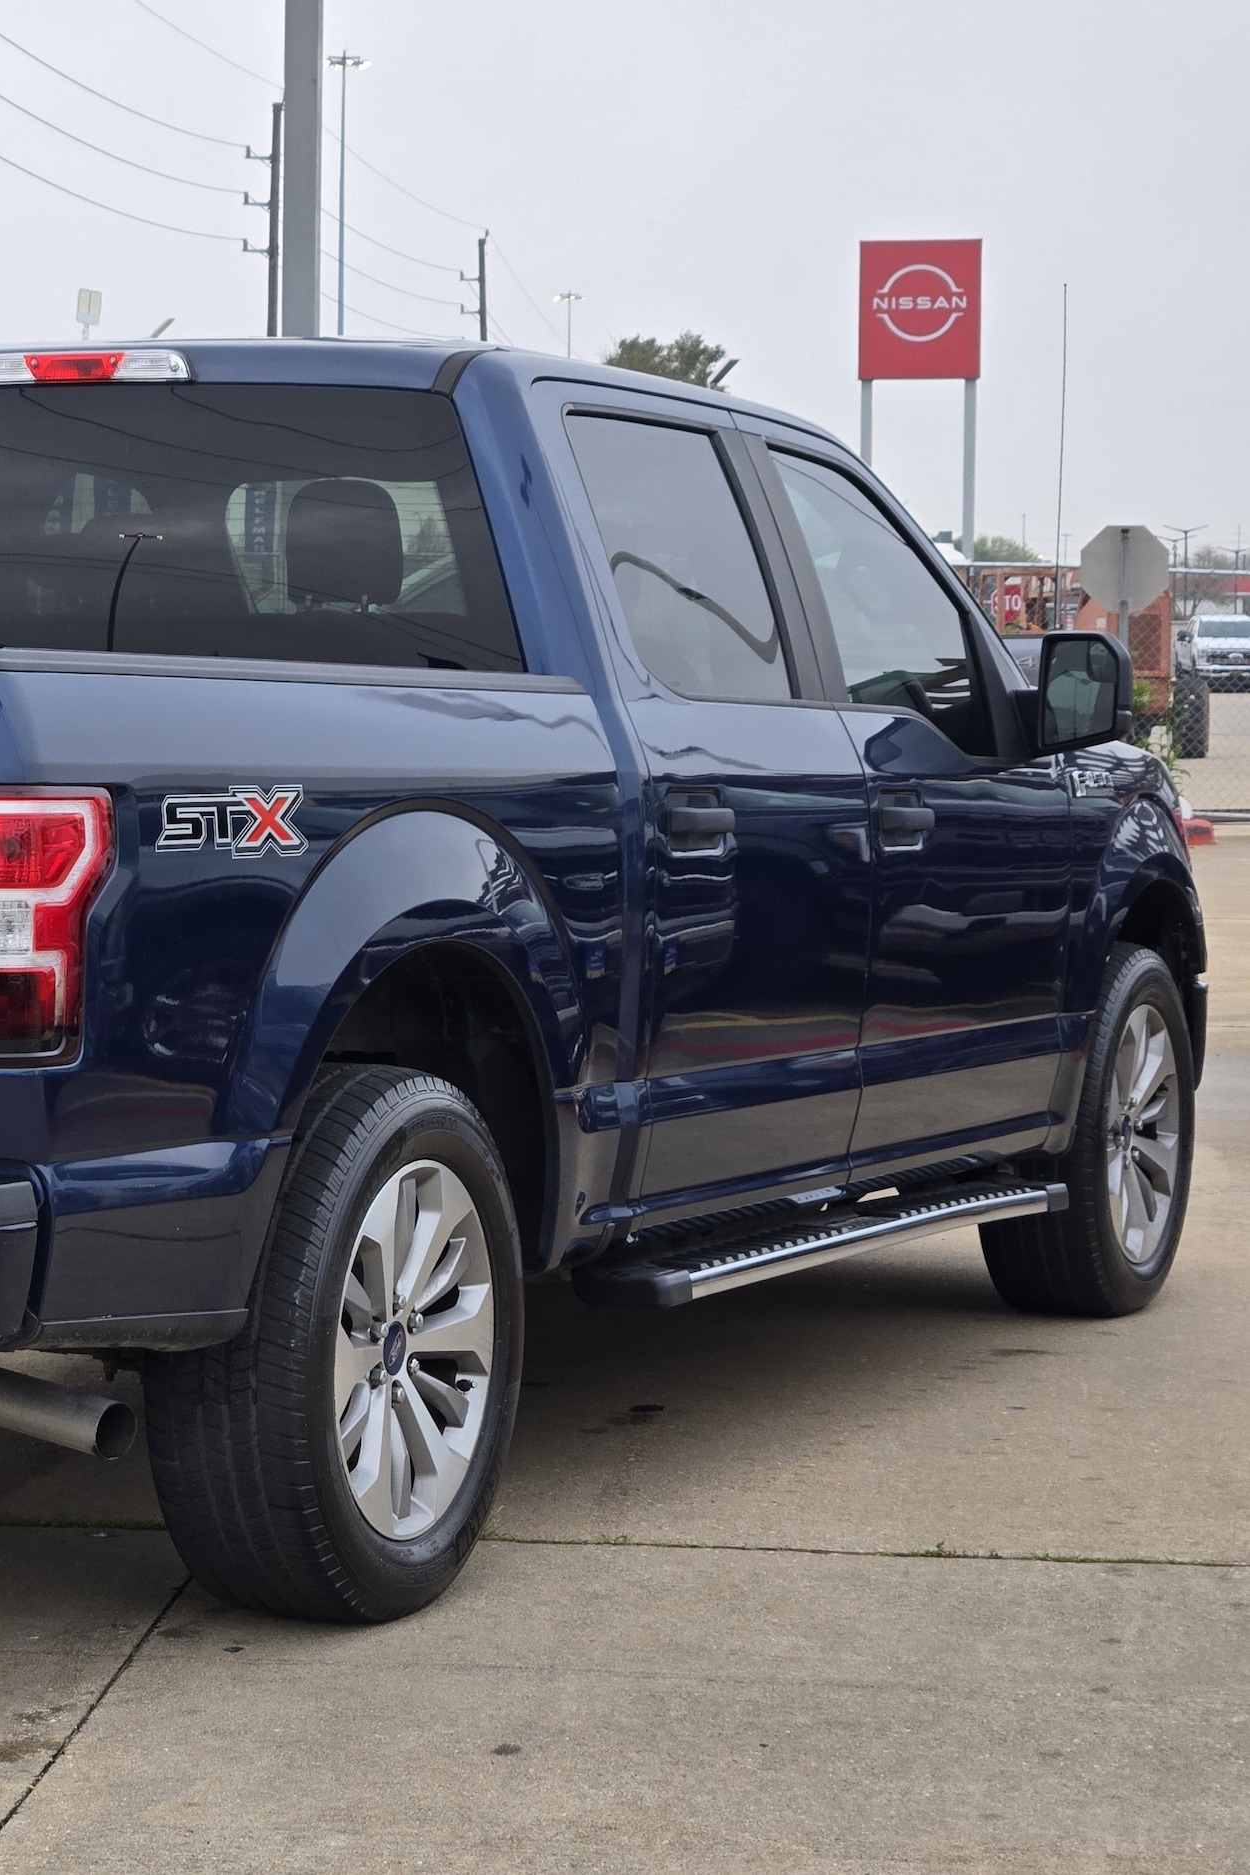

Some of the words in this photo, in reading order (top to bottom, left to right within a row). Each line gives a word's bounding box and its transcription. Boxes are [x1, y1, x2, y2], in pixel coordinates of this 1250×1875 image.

[872, 295, 968, 310] NISSAN
[994, 594, 1022, 612] TO
[155, 783, 309, 860] STX
